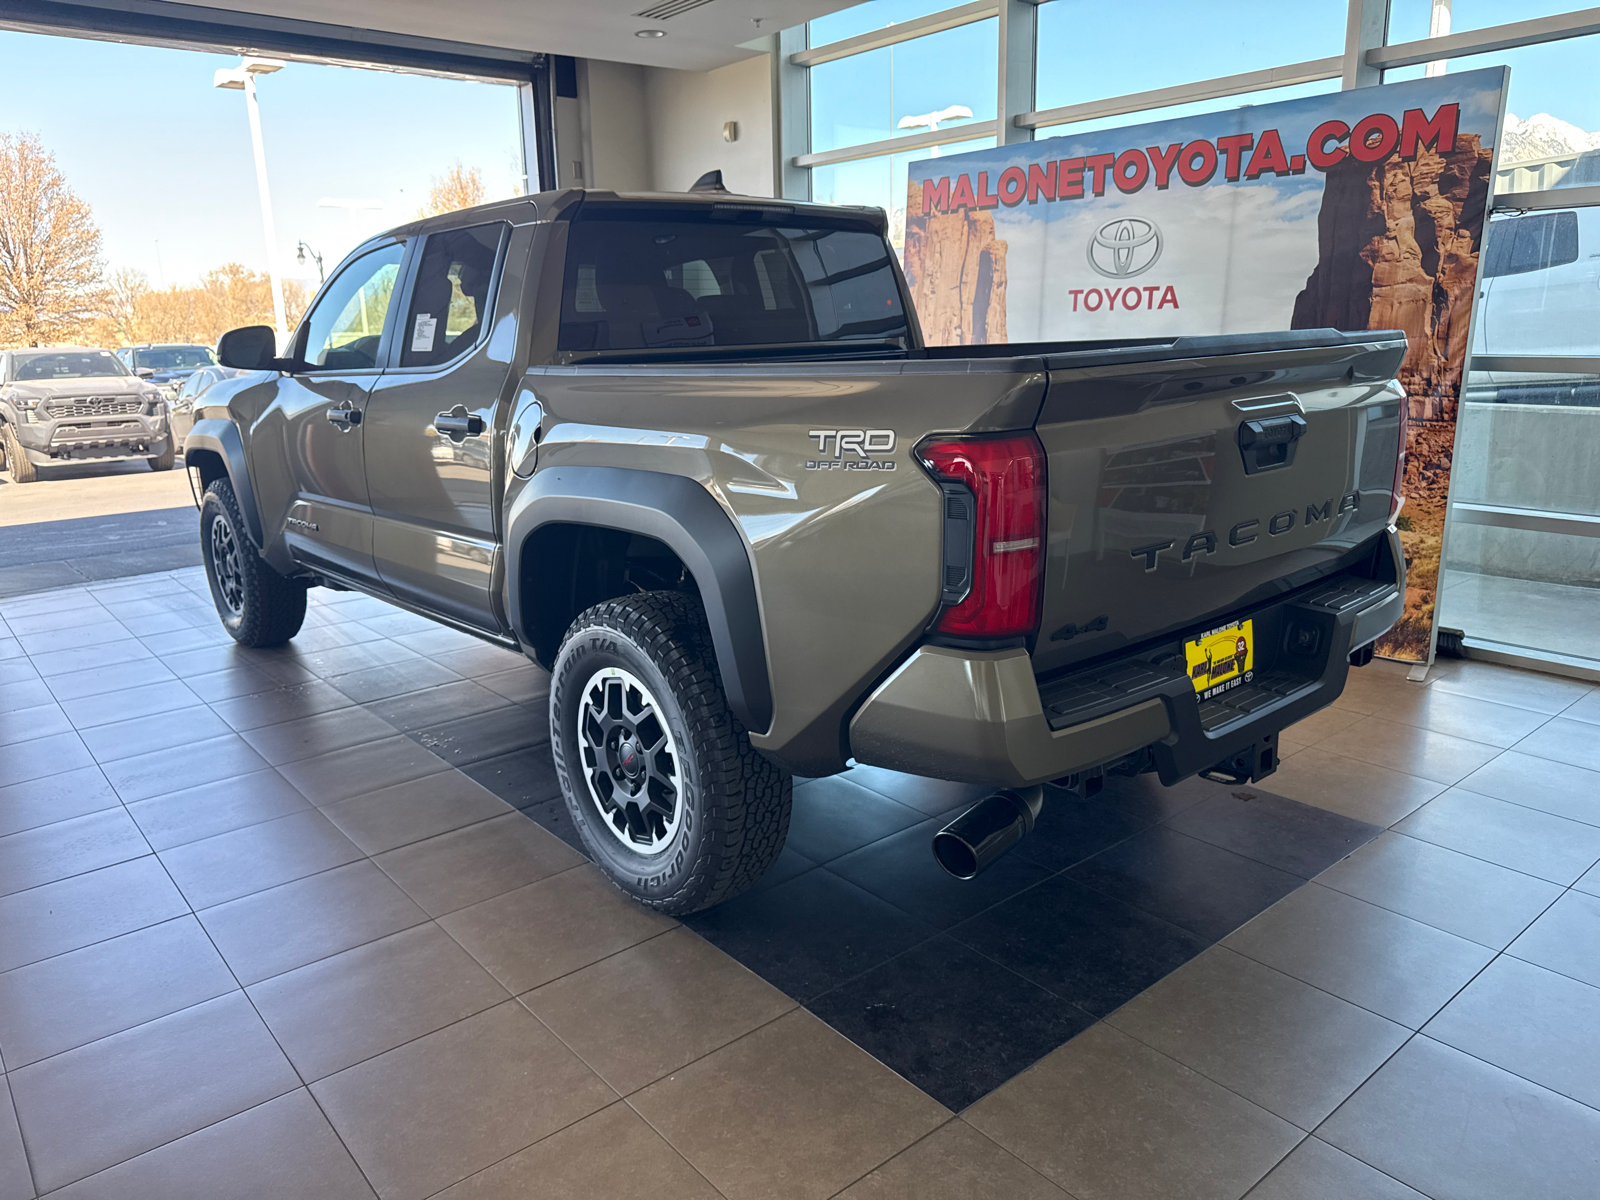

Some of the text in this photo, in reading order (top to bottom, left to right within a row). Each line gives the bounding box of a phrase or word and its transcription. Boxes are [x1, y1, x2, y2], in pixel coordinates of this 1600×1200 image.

[921, 102, 1461, 216] MALONETOYOTA.COM
[1068, 285, 1180, 312] TOYOTA
[808, 429, 898, 460] TRD
[805, 460, 897, 471] OFF ROAD
[1130, 490, 1361, 572] TACOMA
[589, 637, 620, 657] T/A
[1204, 676, 1242, 700] WE MAKE IT EASY
[637, 728, 695, 891] BFGoodrich
